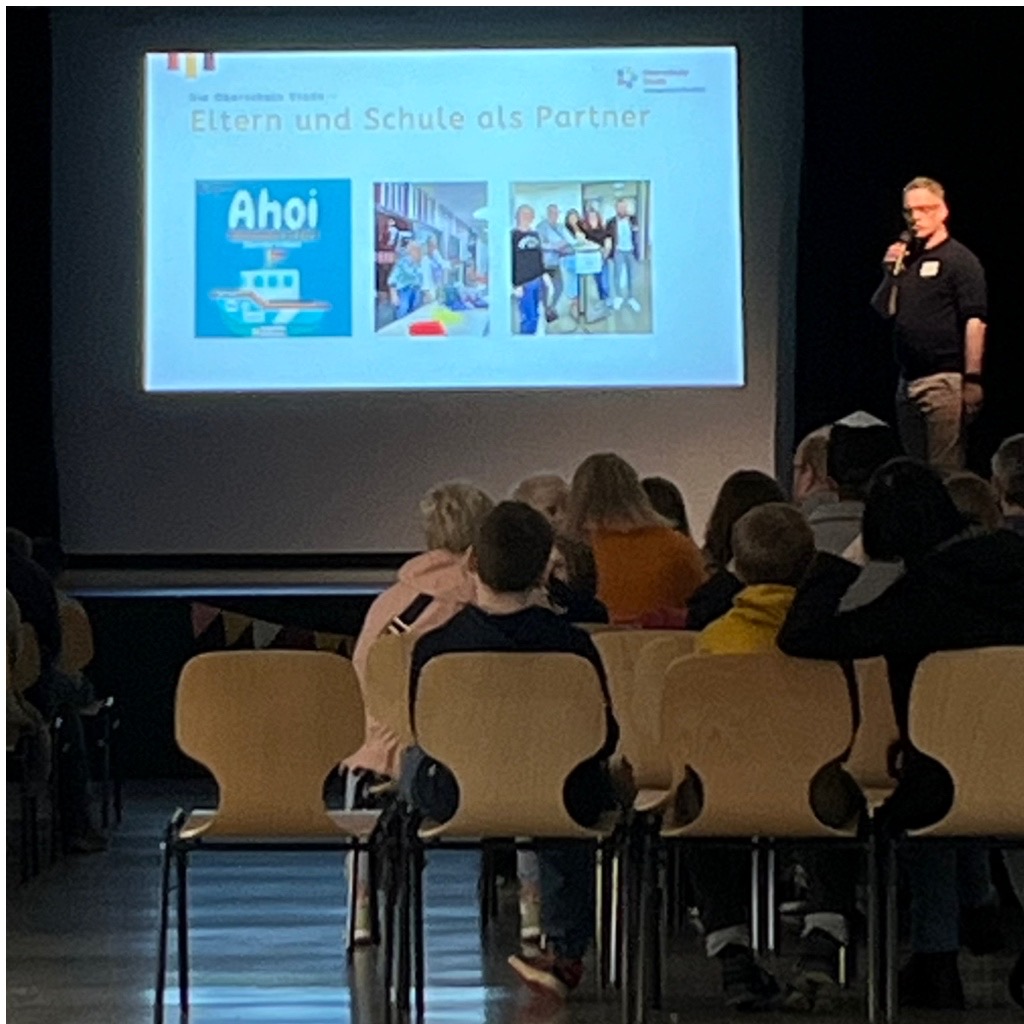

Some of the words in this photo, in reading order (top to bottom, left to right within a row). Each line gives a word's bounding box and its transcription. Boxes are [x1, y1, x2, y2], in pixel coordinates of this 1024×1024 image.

[191, 109, 282, 132] Eltern
[296, 106, 351, 131] und
[364, 106, 464, 131] Schule
[477, 105, 523, 130] als
[536, 105, 650, 128] Partner
[228, 187, 318, 231] Ahoi
